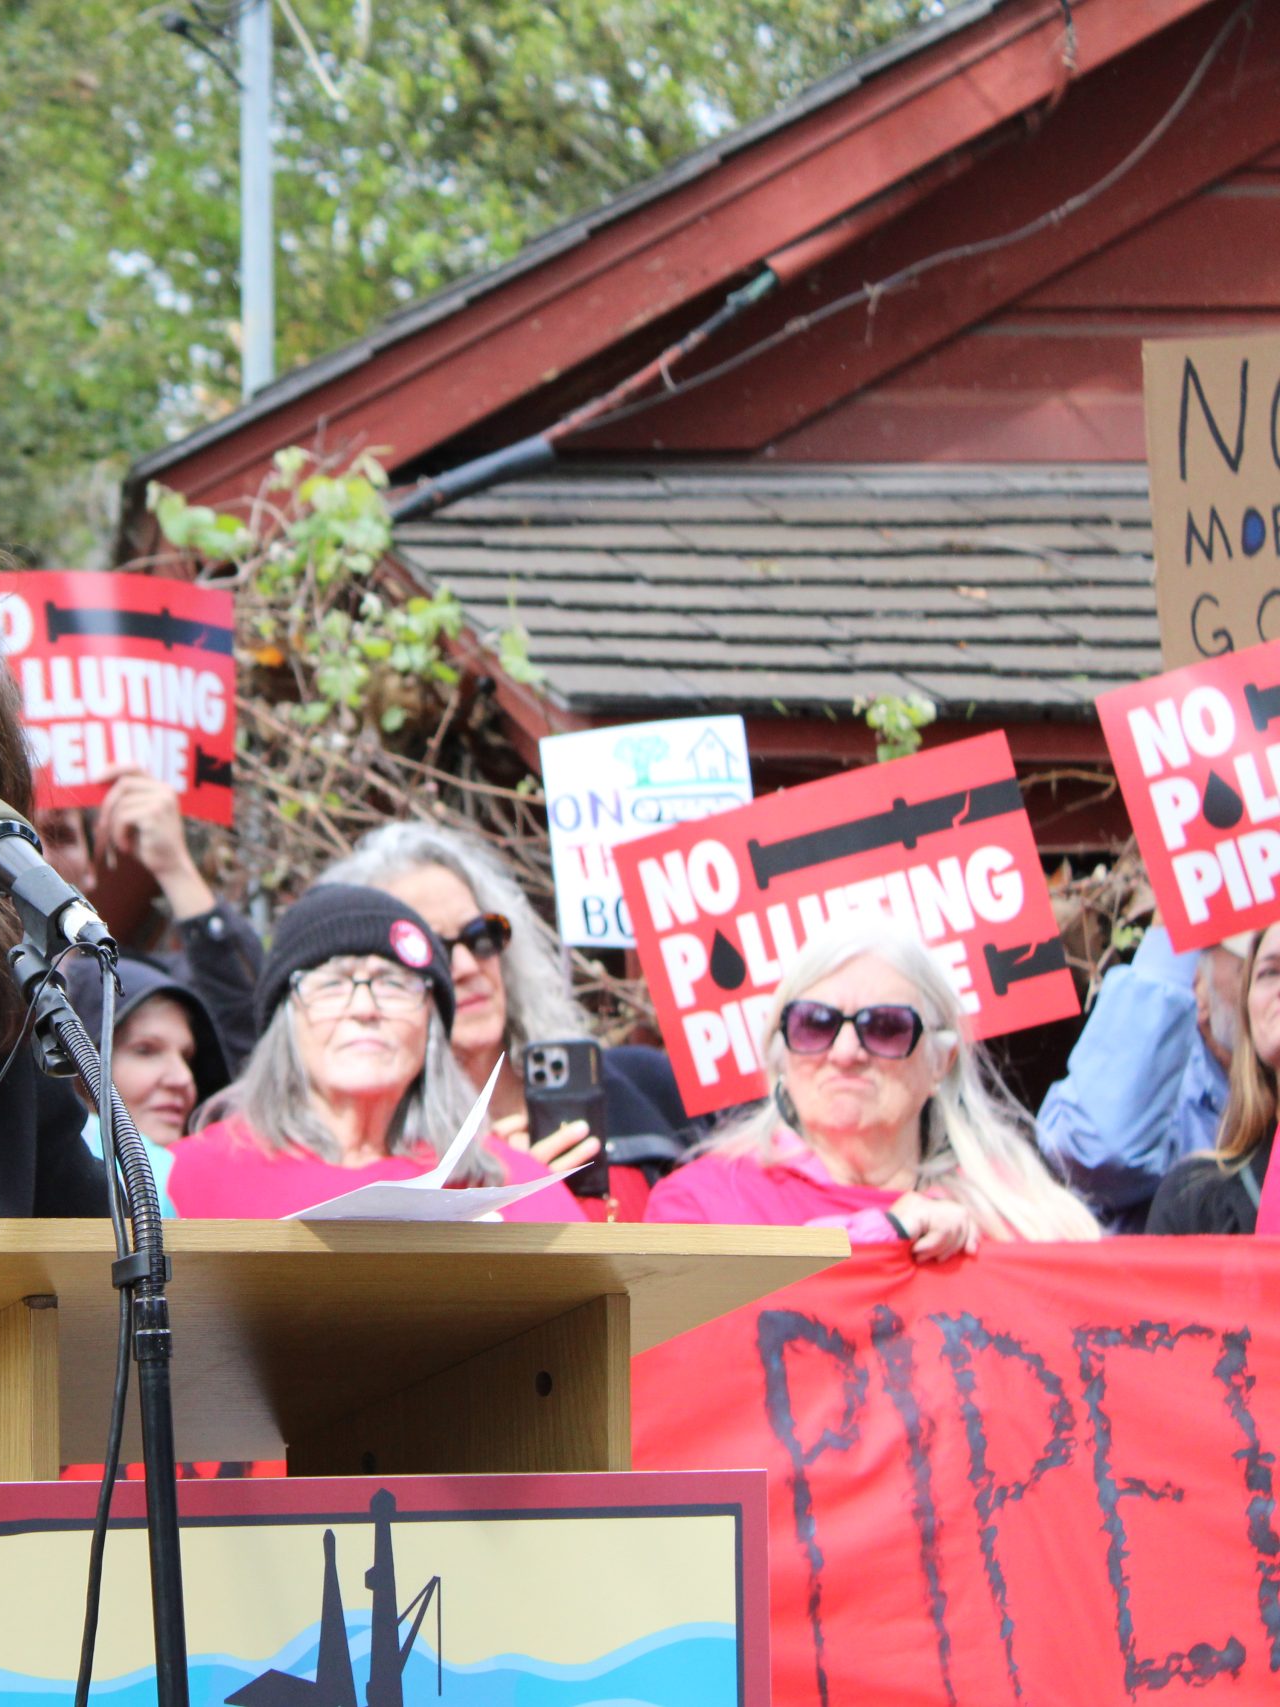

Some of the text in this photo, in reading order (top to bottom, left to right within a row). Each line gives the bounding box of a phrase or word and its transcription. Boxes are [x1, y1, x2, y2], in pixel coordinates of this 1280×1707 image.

[1178, 354, 1280, 482] N
[1127, 685, 1236, 778] NO
[550, 789, 624, 832] ON
[637, 839, 740, 932] NO
